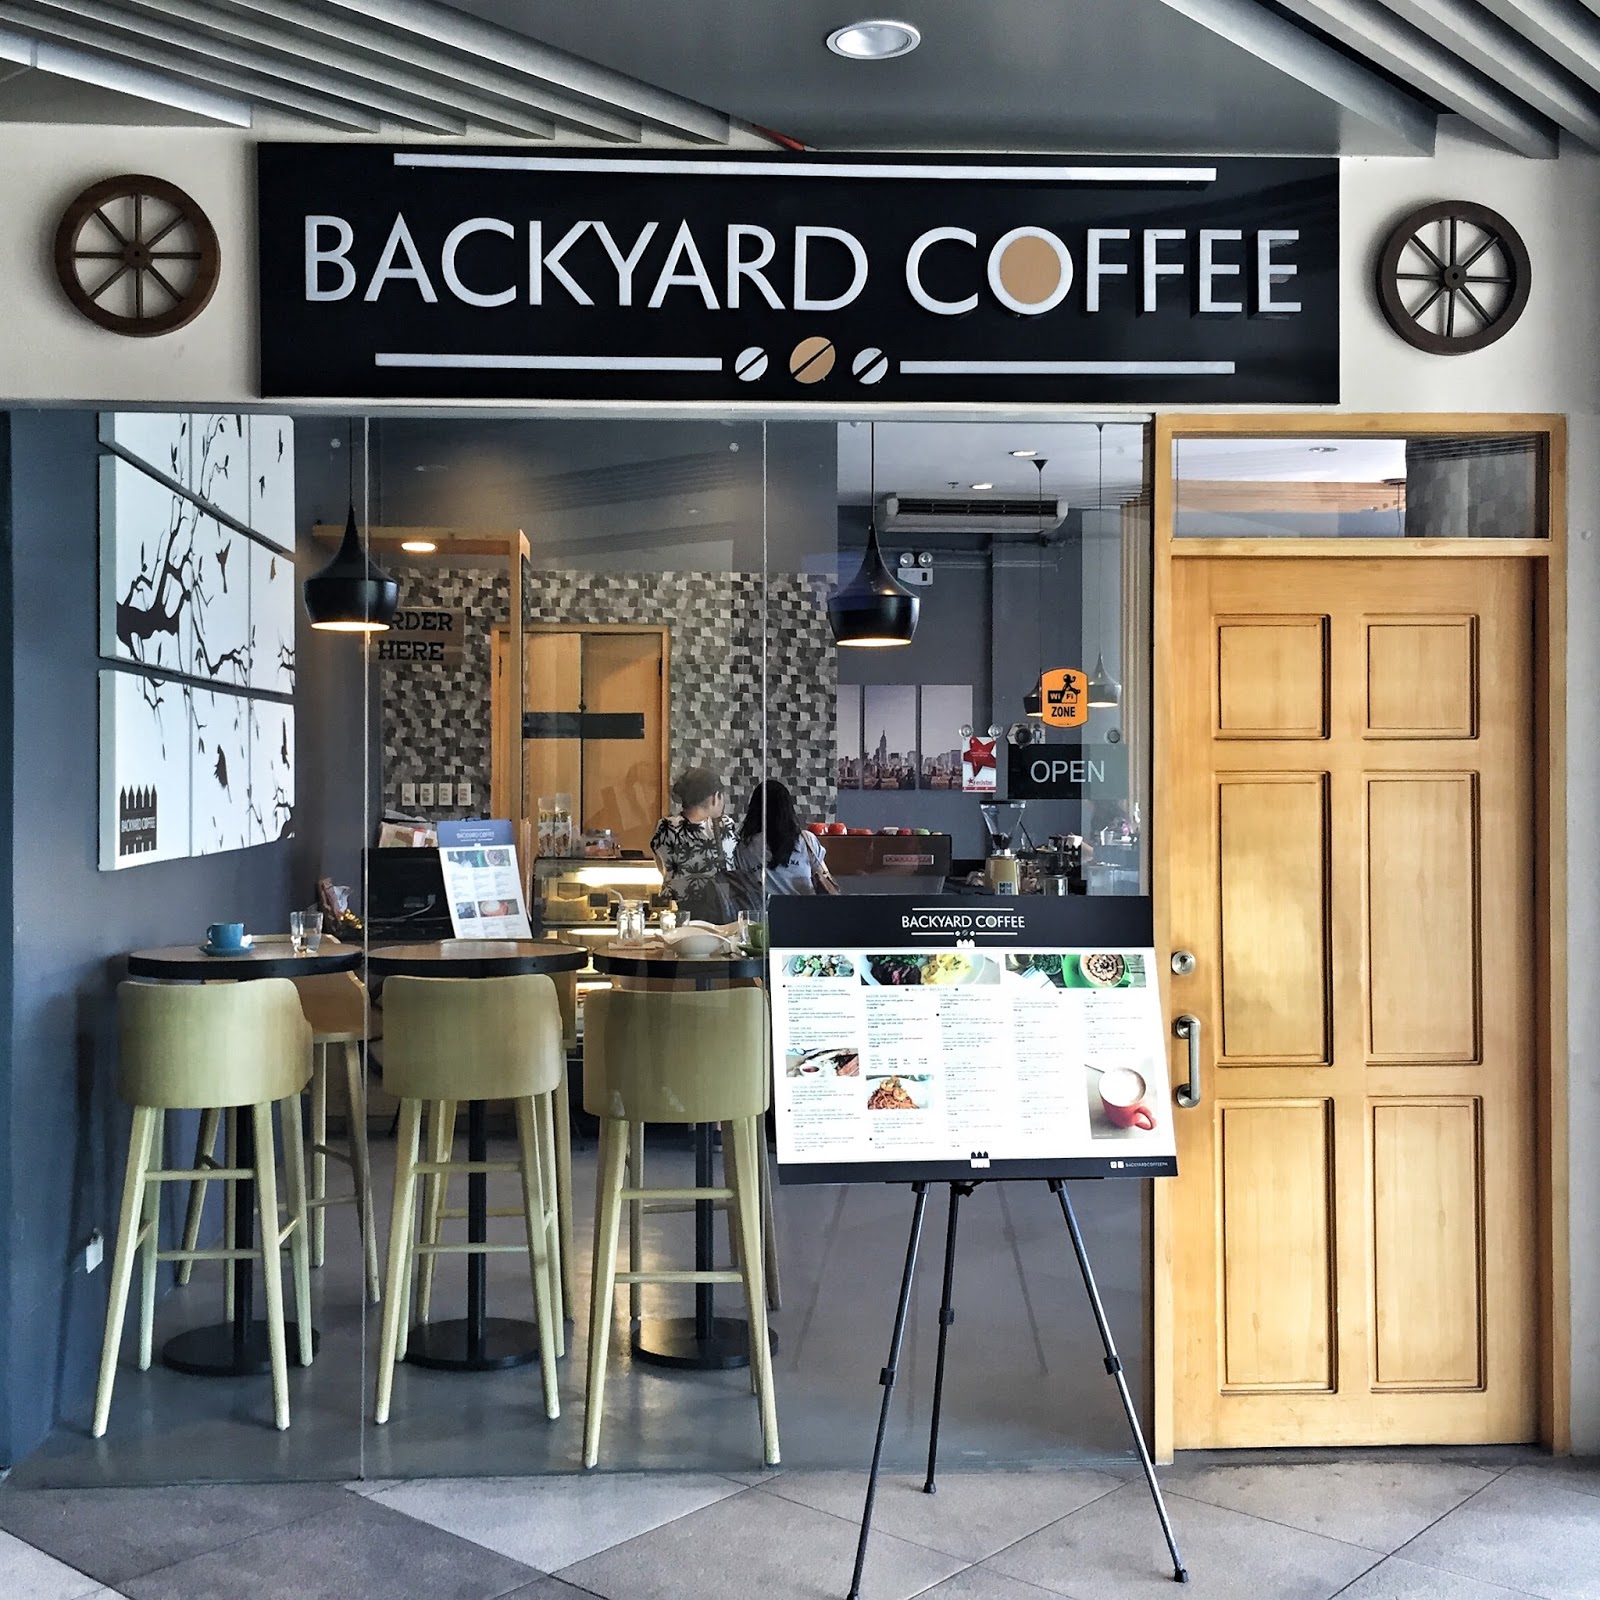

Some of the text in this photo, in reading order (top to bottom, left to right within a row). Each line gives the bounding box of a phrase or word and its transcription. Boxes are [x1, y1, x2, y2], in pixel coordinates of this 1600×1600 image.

[305, 212, 1301, 315] BACKYARD COFFEE
[390, 611, 453, 631] RDER
[378, 640, 444, 661] HERE
[1051, 706, 1076, 718] ZONE
[1030, 759, 1105, 783] OPEN
[901, 915, 1025, 928] BACKYARD COFFEE
